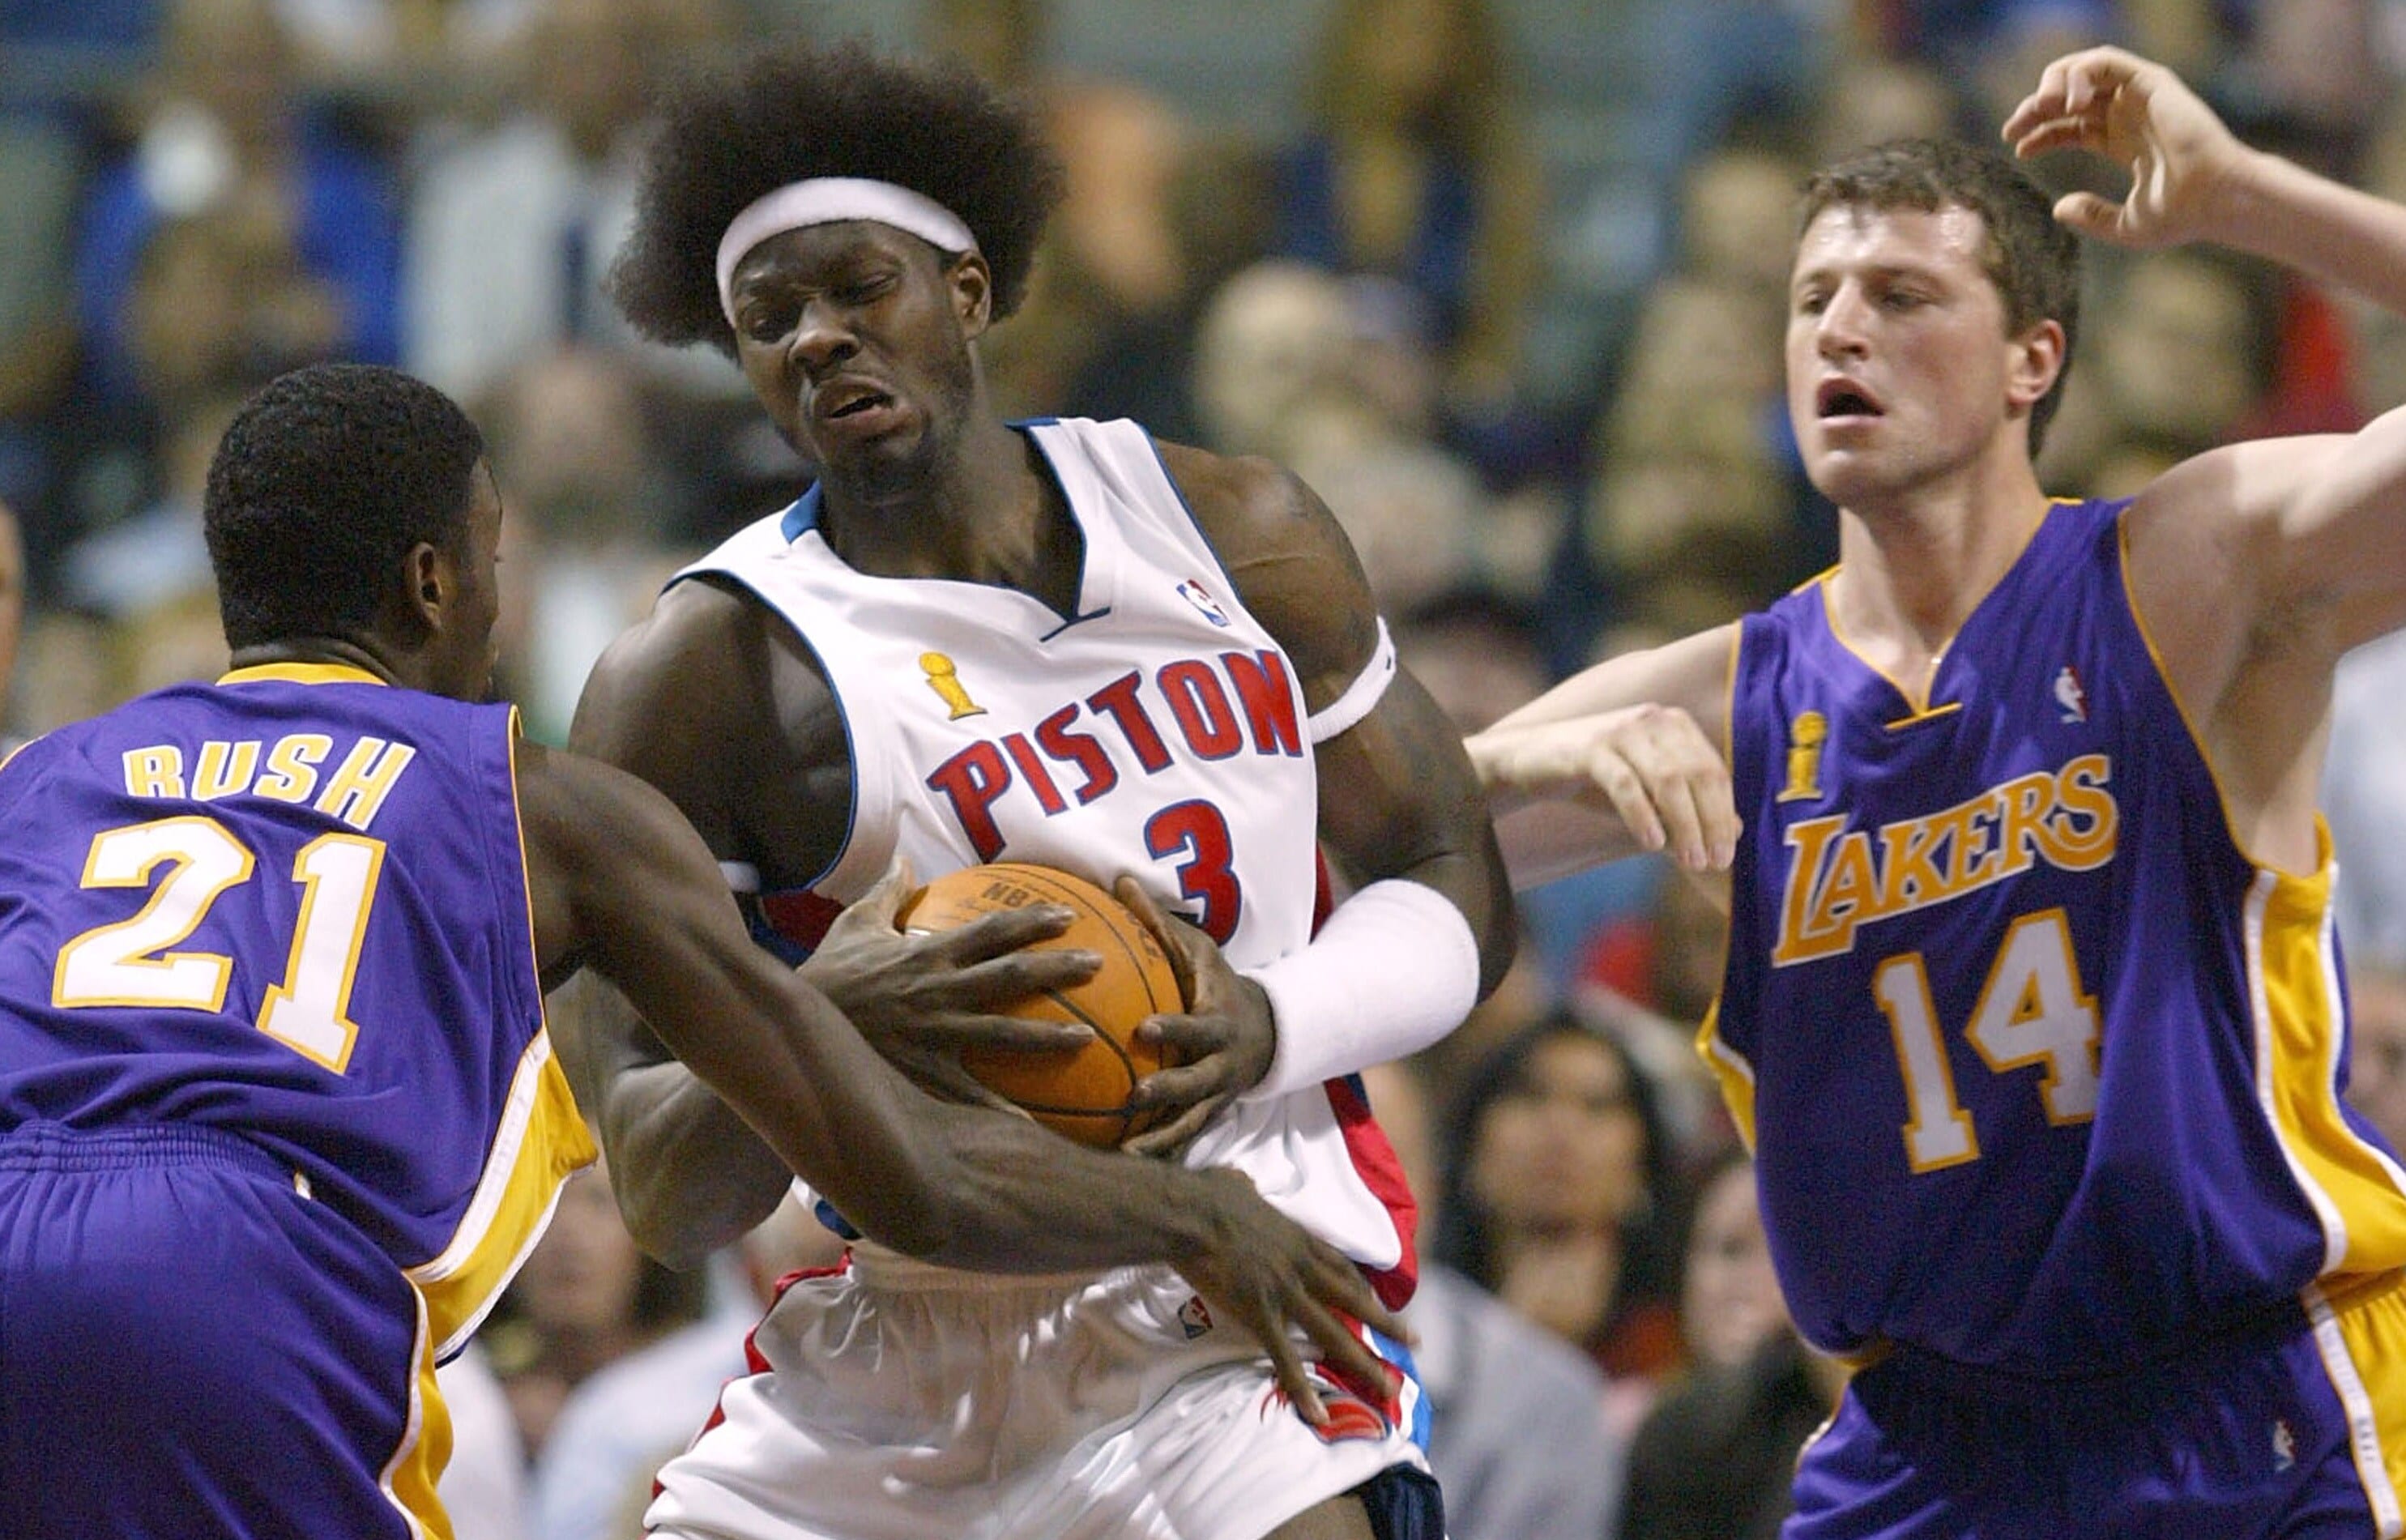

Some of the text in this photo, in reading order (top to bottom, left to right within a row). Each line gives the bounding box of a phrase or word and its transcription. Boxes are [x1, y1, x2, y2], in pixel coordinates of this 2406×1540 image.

[123, 734, 416, 832] RUSH
[925, 650, 1303, 863] PISTON
[1772, 753, 2120, 967] LAKERS
[52, 815, 386, 1076] 21
[1144, 798, 1242, 947] 3
[1872, 907, 2103, 1175] 14
